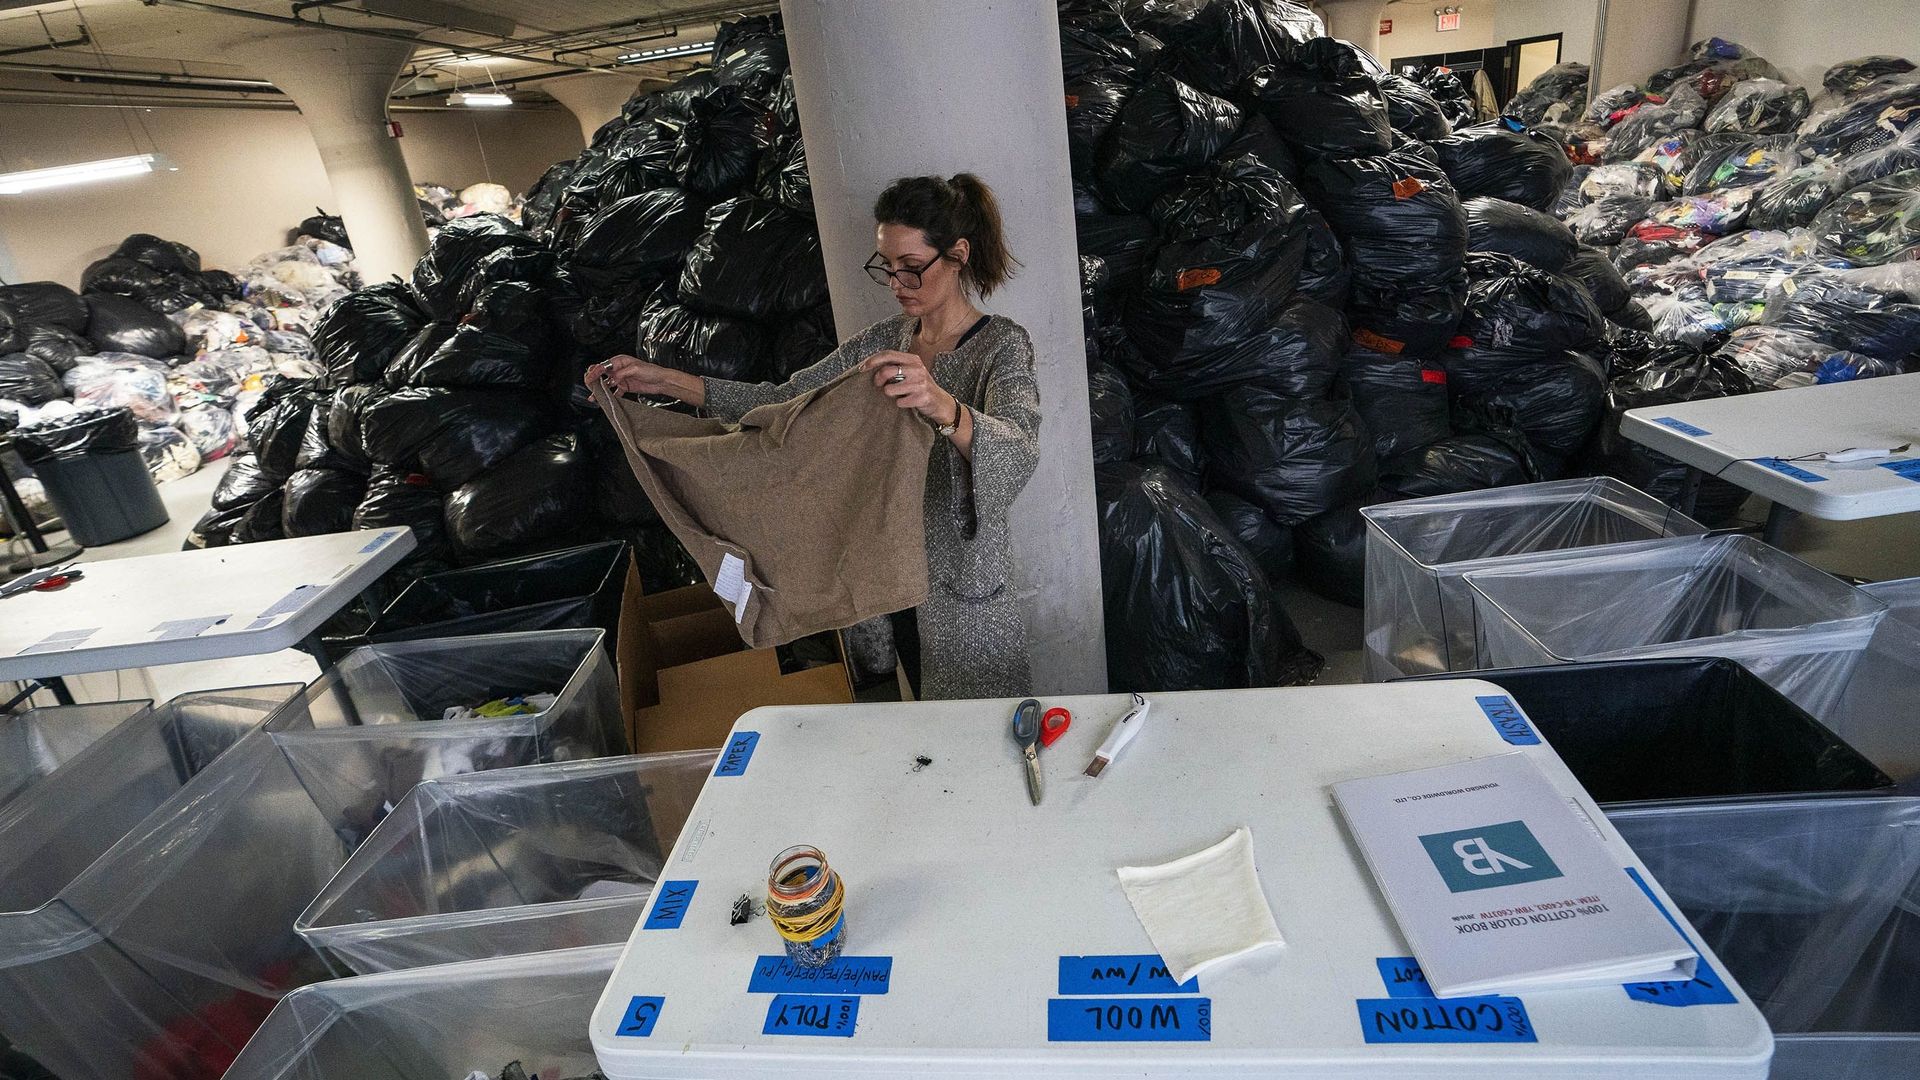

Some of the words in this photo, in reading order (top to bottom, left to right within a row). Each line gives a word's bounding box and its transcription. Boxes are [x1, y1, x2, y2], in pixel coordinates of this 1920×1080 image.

[1441, 14, 1458, 30] EXIT
[1484, 700, 1532, 737] TRASH
[721, 735, 753, 772] PAPER
[1422, 788, 1465, 799] WORLDWIDE
[1453, 837, 1534, 875] YB
[654, 888, 688, 920] MIX
[1577, 903, 1610, 916] 100%
[1578, 895, 1601, 904] ITEM:
[1455, 922, 1489, 935] BOOK
[1490, 916, 1528, 930] COLOR
[1531, 910, 1576, 925] COTTON
[626, 1002, 657, 1031] 5
[775, 1004, 831, 1029] POLY
[1085, 1005, 1180, 1031] WOOL
[1375, 1003, 1503, 1034] COTTON
